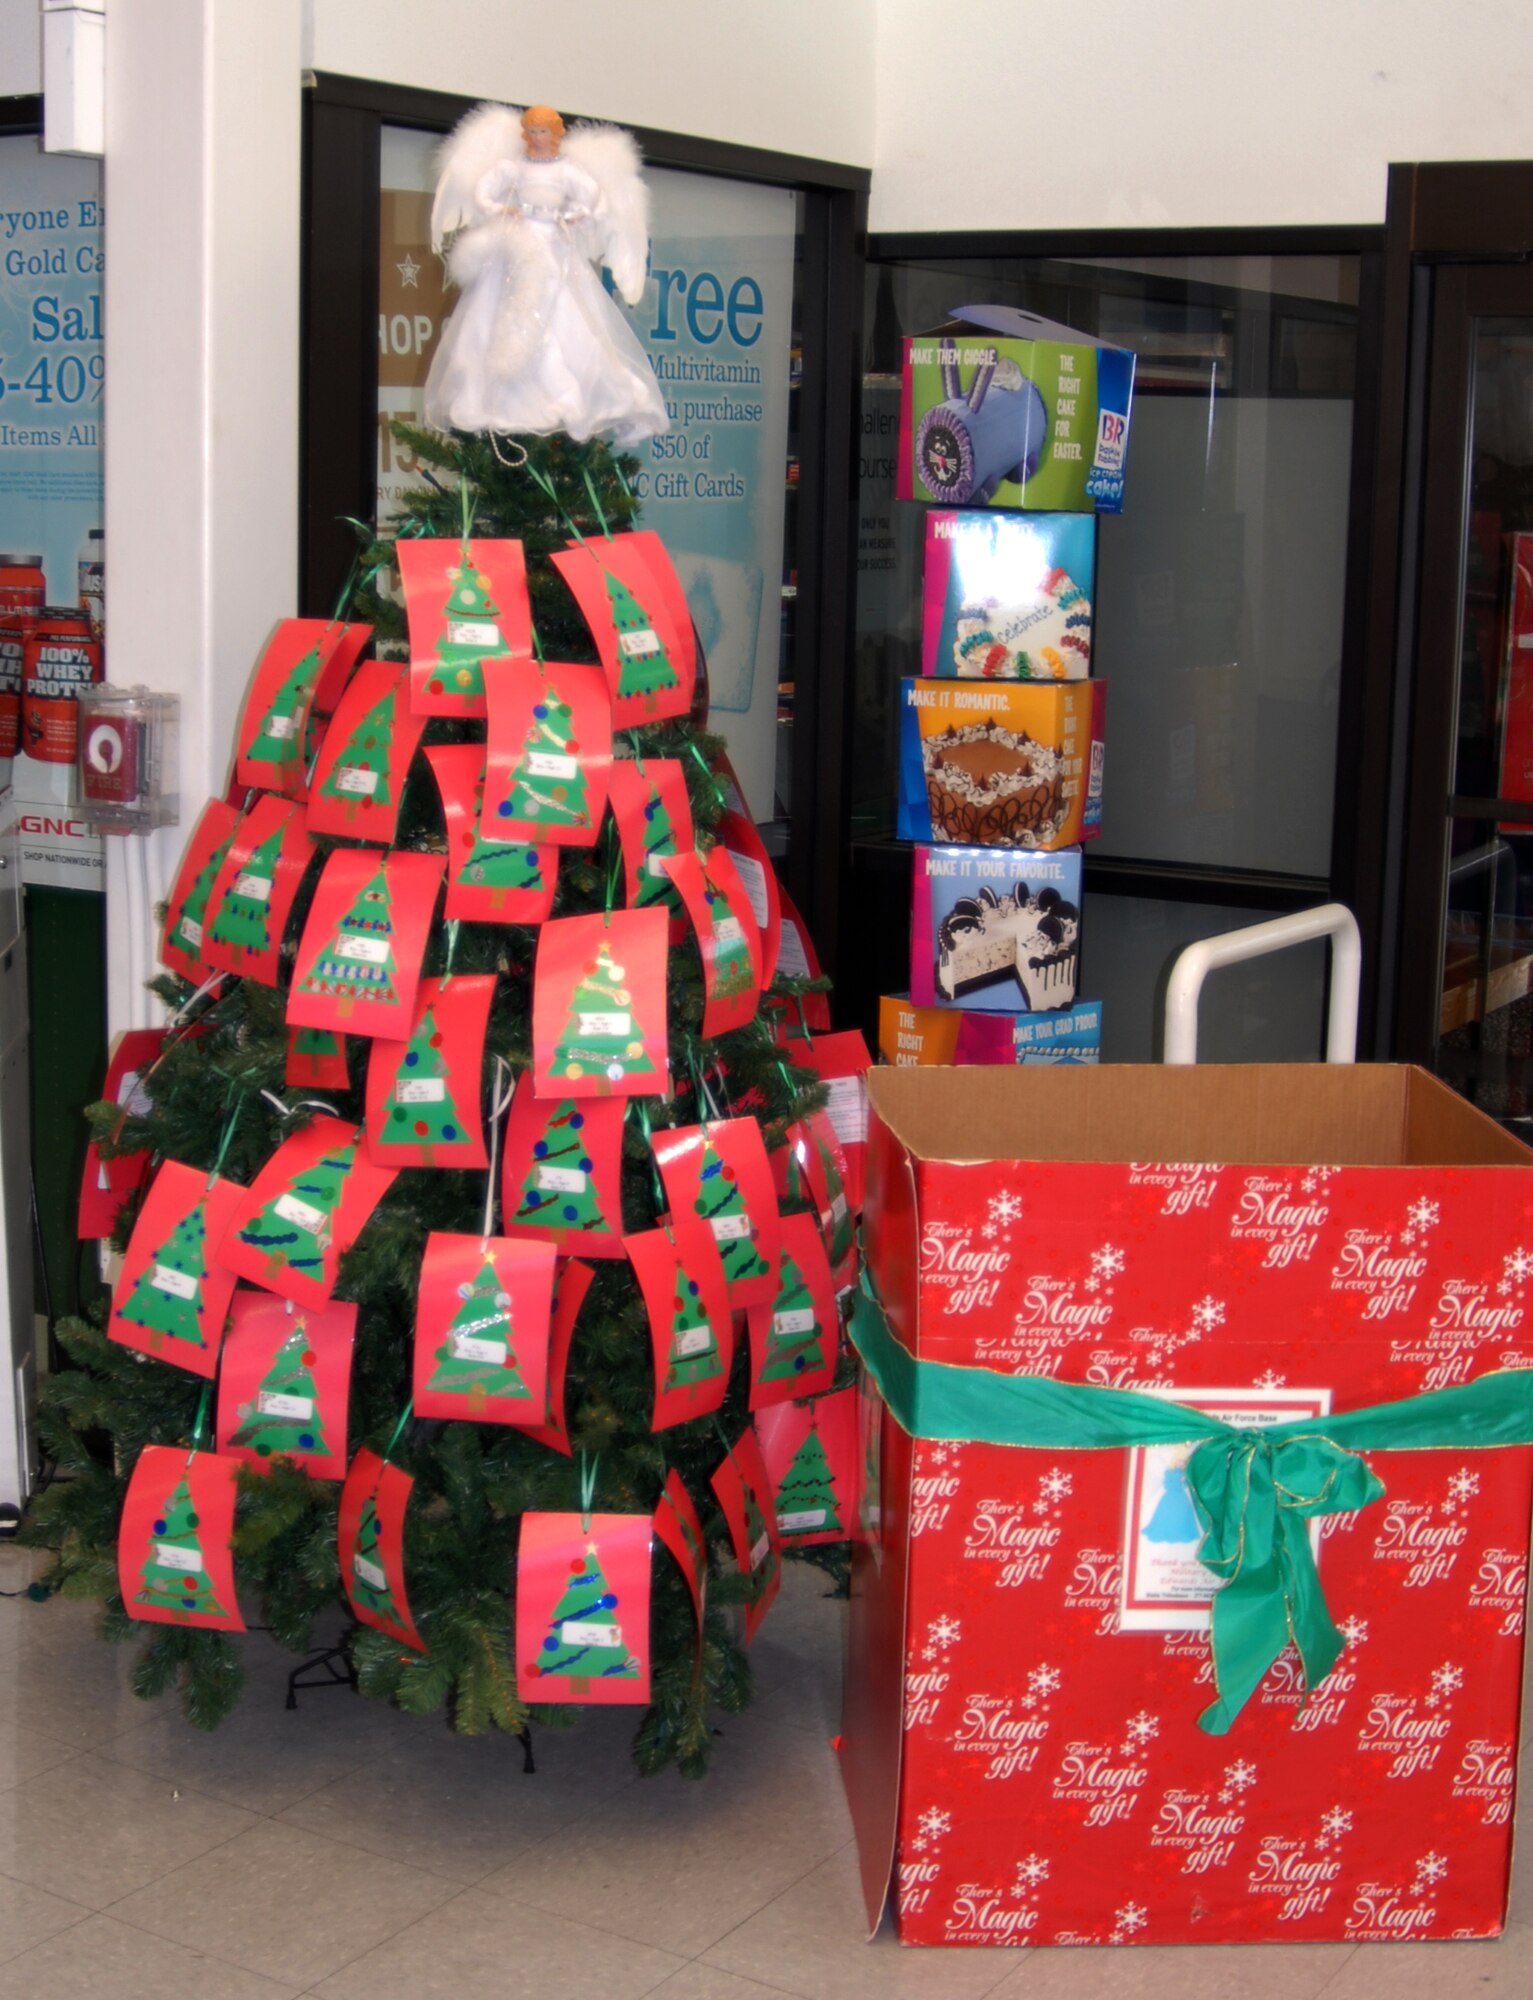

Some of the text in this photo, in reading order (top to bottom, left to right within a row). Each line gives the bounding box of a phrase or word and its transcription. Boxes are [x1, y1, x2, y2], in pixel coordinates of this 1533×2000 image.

[5, 248, 66, 275] Gold
[909, 348, 997, 366] MAKE THEM GIGGLE.
[1060, 355, 1074, 372] THE
[1058, 376, 1081, 395] RIGHT
[683, 396, 762, 426] purchase
[1056, 398, 1076, 416] CAKE
[1, 425, 97, 446] Items All
[1055, 420, 1070, 437] FOR
[1102, 414, 1125, 444] BR
[652, 434, 711, 459] $50 of
[1053, 442, 1082, 460] EASTER.
[654, 472, 690, 498] Gift
[694, 472, 745, 498] Cards
[934, 521, 964, 540] MAK
[39, 647, 90, 664] 100%
[36, 662, 93, 680] WHEY
[907, 689, 1010, 711] MAKE IT ROMANTIC.
[20, 815, 85, 838] GNC
[23, 851, 44, 861] SHOP
[45, 853, 91, 867] NATIONWIDE
[926, 859, 1065, 880] MAKE IT YOUR FAVORITE.
[899, 1011, 915, 1029] THE
[897, 1032, 924, 1051] RIGHT
[1013, 1025, 1033, 1044] MAKE
[1035, 1021, 1053, 1040] YOUR
[896, 1053, 919, 1066] CAKE
[1129, 1171, 1177, 1189] in every
[1243, 1176, 1292, 1191] There's
[1160, 1179, 1217, 1215] gift!
[1232, 1192, 1329, 1236] Magic
[925, 1221, 973, 1237] There's
[1230, 1226, 1278, 1242] in every
[1343, 1229, 1391, 1244] There's
[1262, 1233, 1319, 1268] gift!
[919, 1238, 1010, 1283] Magic
[1332, 1245, 1427, 1288] Magic
[926, 1276, 959, 1289] every
[1027, 1274, 1076, 1290] There's
[1331, 1279, 1377, 1294] in every
[1441, 1280, 1488, 1294] There's
[943, 1280, 1000, 1316] gift!
[1362, 1285, 1417, 1320] gift!
[1016, 1290, 1112, 1336] Magic
[1430, 1295, 1523, 1337] Magic
[1014, 1326, 1062, 1342] in every
[1129, 1327, 1176, 1342] There's
[1428, 1328, 1474, 1343] in every
[1090, 1350, 1137, 1366] There's
[1419, 1356, 1474, 1390] gift!
[1235, 1413, 1256, 1422] Force
[1258, 1414, 1277, 1422] Base
[976, 1499, 1024, 1513] There's
[1386, 1498, 1432, 1513] There's
[964, 1514, 1060, 1556] Magic
[1374, 1514, 1467, 1557] Magic
[963, 1547, 1010, 1562] in every
[1374, 1547, 1419, 1563] in every
[995, 1553, 1051, 1586] gift!
[1404, 1554, 1458, 1588] gift!
[1064, 1595, 1111, 1611] in every
[1468, 1595, 1515, 1611] in every
[965, 1693, 1013, 1707] There's
[1370, 1694, 1416, 1708] There's
[1291, 1699, 1346, 1731] gift!
[954, 1708, 1049, 1749] Magic
[1359, 1708, 1450, 1749] Magic
[953, 1740, 999, 1755] in every
[1065, 1741, 1112, 1755] There's
[1358, 1740, 1403, 1754] in every
[1465, 1740, 1511, 1755] There's
[984, 1746, 1039, 1778] gift!
[1388, 1746, 1440, 1778] gift!
[1054, 1756, 1148, 1798] Magic
[1053, 1788, 1099, 1803] in every
[1163, 1789, 1210, 1803] There's
[1452, 1785, 1497, 1801] in every
[1083, 1794, 1138, 1827] gift!
[1152, 1804, 1244, 1844] Magic
[1151, 1835, 1196, 1850] in every
[1260, 1837, 1306, 1851] There's
[1181, 1841, 1235, 1873] gift!
[1249, 1851, 1340, 1891] Magic
[956, 1883, 1003, 1897] There's
[1248, 1882, 1293, 1896] in every
[1356, 1883, 1401, 1897] There's
[1277, 1888, 1331, 1920] gift!
[945, 1898, 1038, 1938] Magic
[1345, 1897, 1436, 1937] Magic
[944, 1929, 990, 1944] in every
